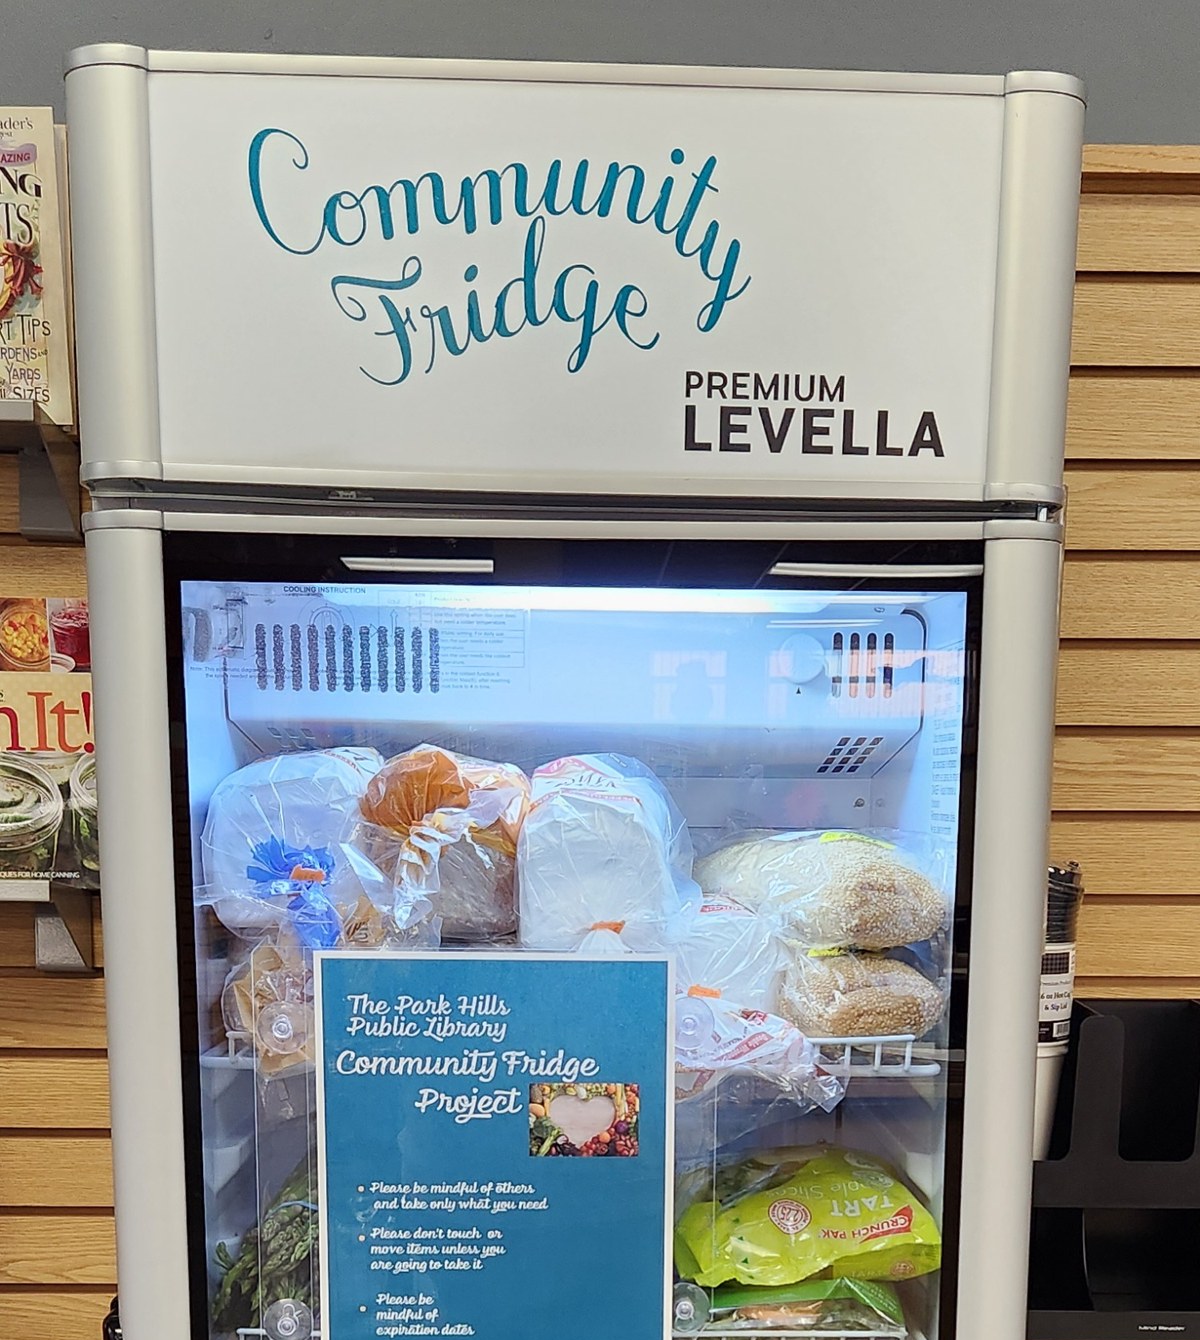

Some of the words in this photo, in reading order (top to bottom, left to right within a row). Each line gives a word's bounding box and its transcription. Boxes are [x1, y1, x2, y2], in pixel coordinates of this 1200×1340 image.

[248, 127, 752, 333] Community
[330, 215, 660, 387] Fridge
[5, 362, 41, 386] YARDS
[685, 371, 846, 403] PREMIUM
[684, 405, 945, 458] LEVELLA
[317, 586, 366, 594] INSTRUCTION
[27, 691, 95, 754] It!
[347, 994, 390, 1015] The
[394, 995, 452, 1016] Park
[458, 995, 511, 1016] Hills
[346, 1017, 420, 1037] Public
[423, 1016, 507, 1043] Library
[336, 1050, 498, 1083] Community
[501, 1050, 600, 1083] Fridge
[414, 1087, 522, 1124] Project
[369, 1182, 411, 1194] Please
[413, 1182, 428, 1194] be
[430, 1182, 478, 1196] mindful
[480, 1183, 494, 1196] of
[495, 1183, 536, 1194] others
[374, 1198, 399, 1210] and
[401, 1197, 428, 1210] take
[430, 1199, 456, 1212] only
[458, 1198, 492, 1210] what
[491, 1201, 517, 1214] you
[518, 1198, 549, 1210] need
[830, 1194, 894, 1217] TART
[369, 1228, 412, 1239] Please
[413, 1228, 445, 1239] don't
[447, 1228, 482, 1239] touch
[487, 1230, 503, 1239] or
[822, 1229, 847, 1240] PAK
[852, 1216, 908, 1239] CRUNCH
[371, 1245, 405, 1255] move
[406, 1243, 440, 1255] items
[441, 1243, 481, 1255] unless
[480, 1245, 506, 1258] you
[371, 1261, 394, 1270] are
[393, 1259, 427, 1274] going
[429, 1259, 442, 1270] to
[444, 1259, 471, 1270] take
[473, 1259, 483, 1270] it
[376, 1293, 417, 1305] Please
[418, 1293, 434, 1305] be
[376, 1308, 424, 1323] mindful
[425, 1308, 439, 1323] of
[376, 1324, 440, 1338] expiration
[441, 1324, 475, 1335] dates
